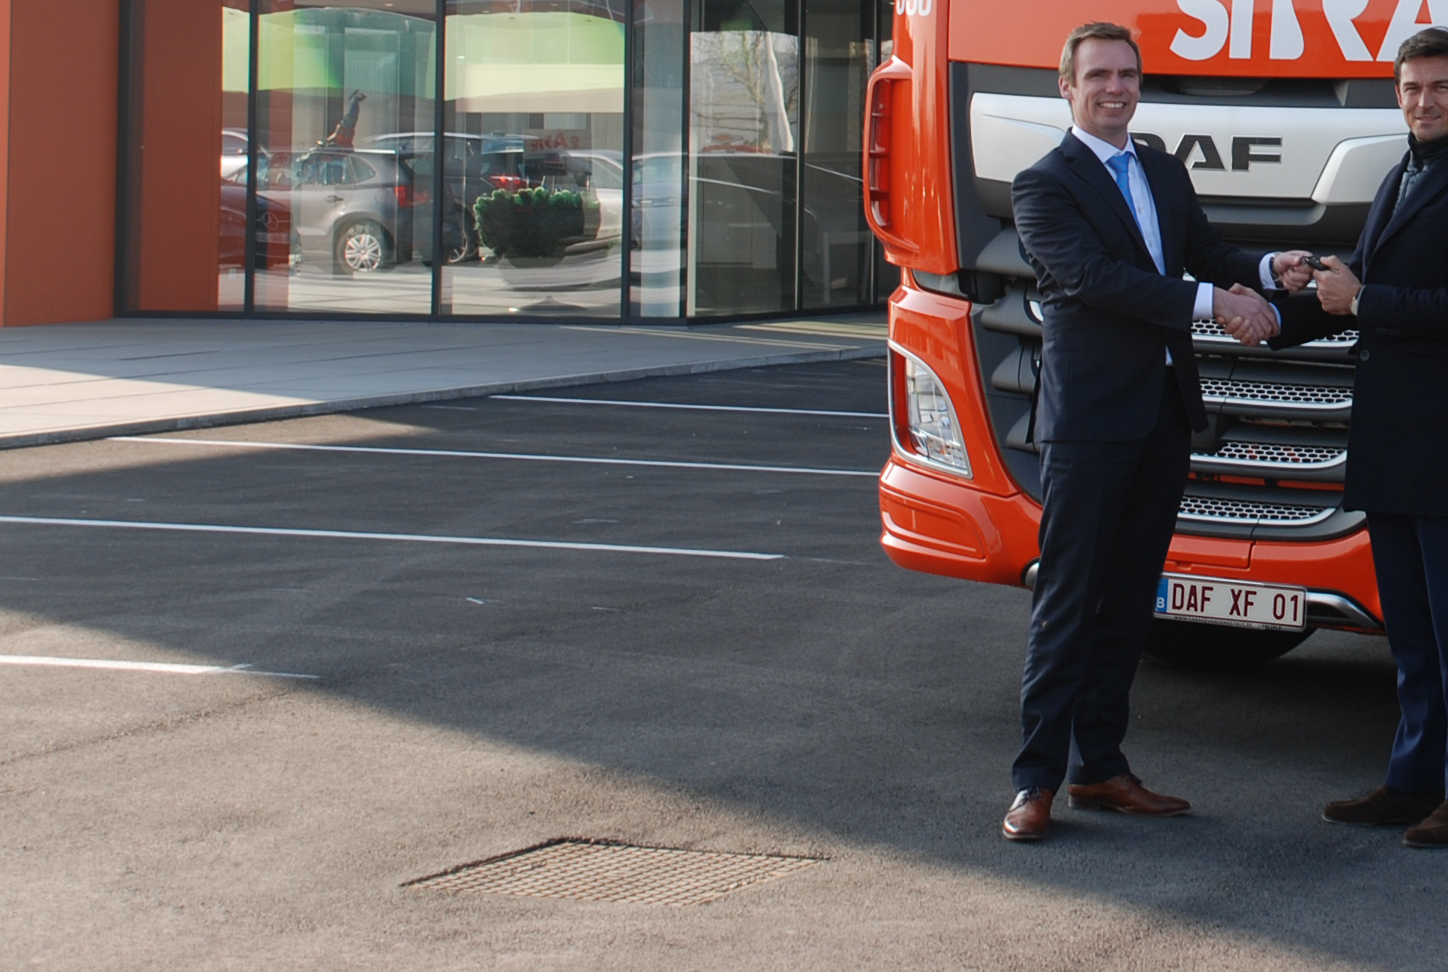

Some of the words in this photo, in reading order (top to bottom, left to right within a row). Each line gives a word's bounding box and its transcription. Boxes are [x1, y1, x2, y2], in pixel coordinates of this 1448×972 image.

[1156, 596, 1165, 609] B
[1171, 583, 1214, 613] DAF
[1229, 588, 1257, 617] XF
[1272, 593, 1299, 622] 01
